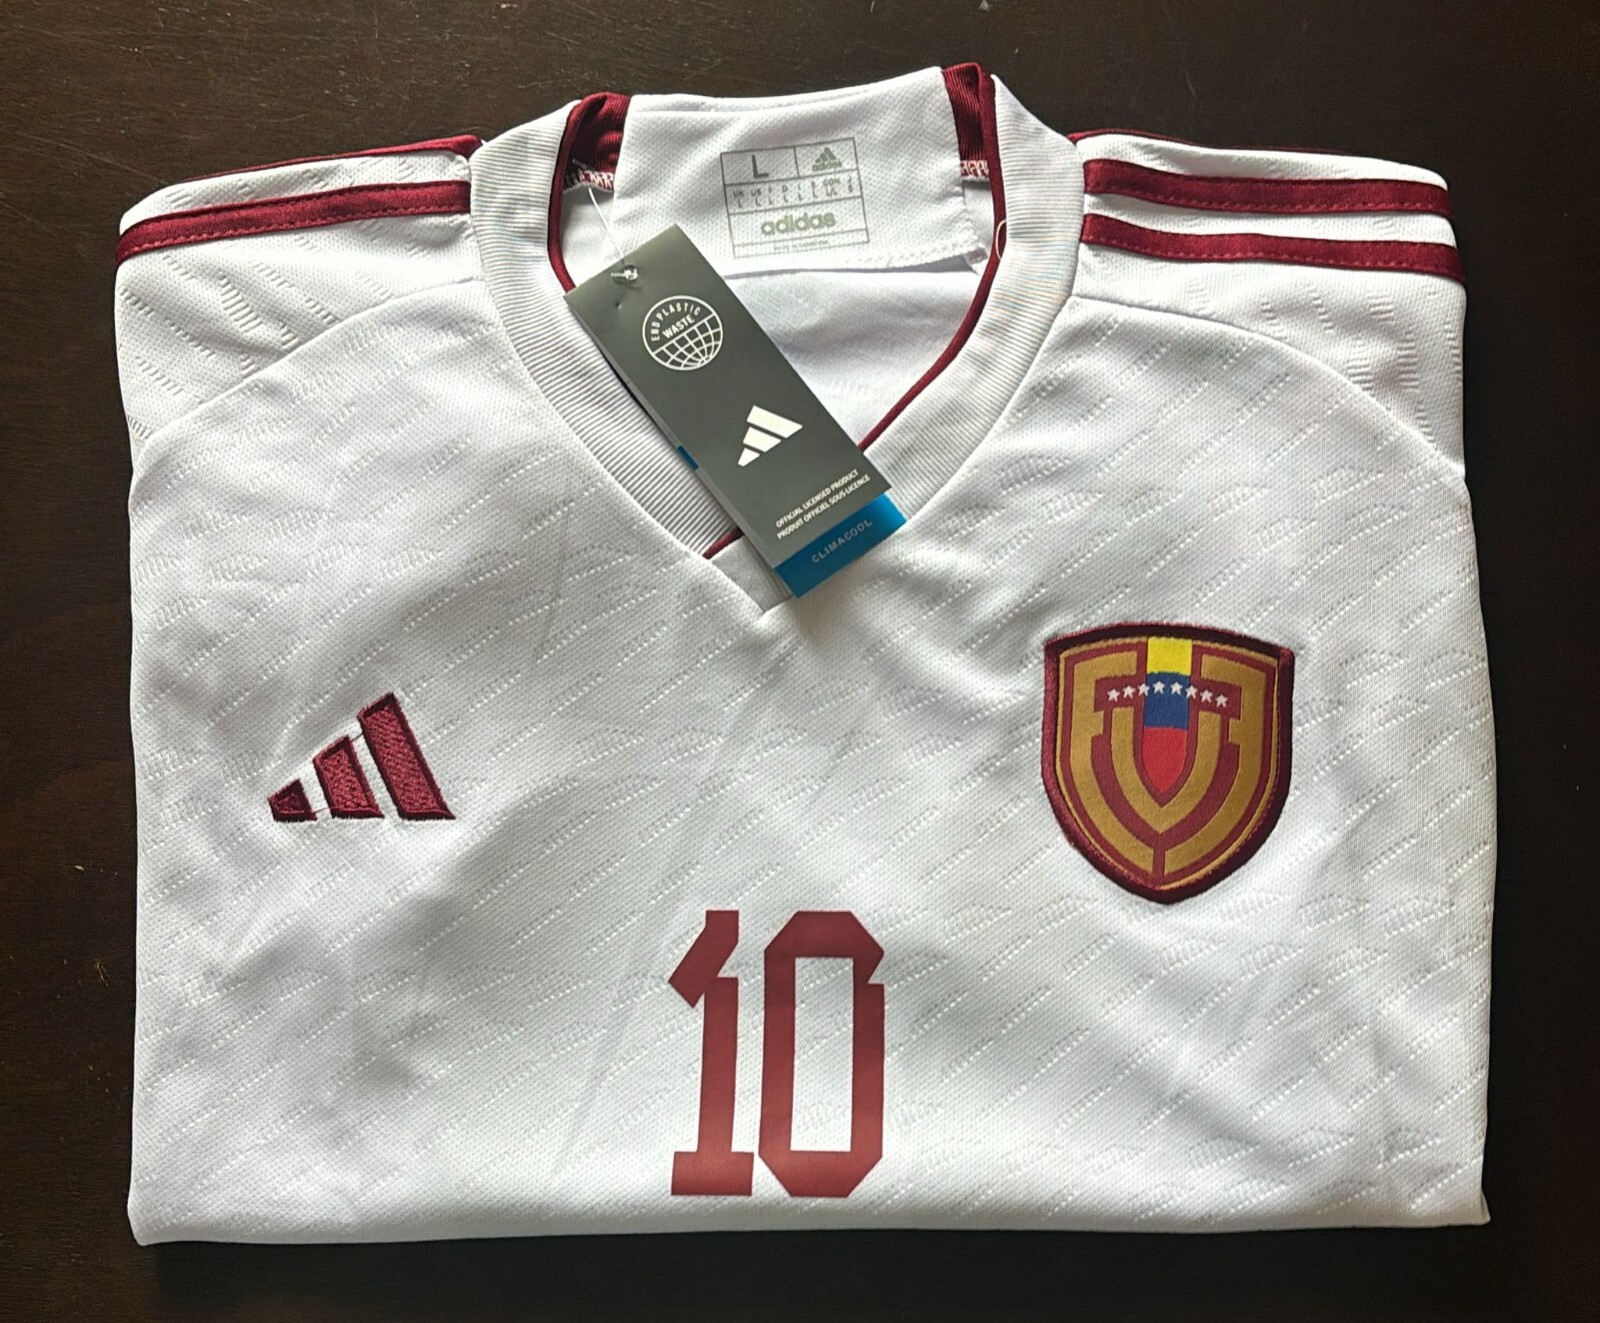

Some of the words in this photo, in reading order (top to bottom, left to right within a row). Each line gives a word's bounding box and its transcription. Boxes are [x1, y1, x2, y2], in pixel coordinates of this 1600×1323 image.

[751, 154, 770, 179] L
[760, 212, 837, 236] adidas
[655, 302, 701, 321] PLASTIC
[650, 321, 661, 342] END
[662, 314, 695, 339] WASTE
[775, 506, 804, 528] OFFICIAL
[802, 487, 832, 511] LICENSED
[830, 468, 859, 491] PRODUCT
[803, 501, 831, 523] OFFICIEL
[828, 489, 847, 505] SOUS
[811, 519, 873, 563] CLIMACOOL
[667, 909, 885, 1198] 10
